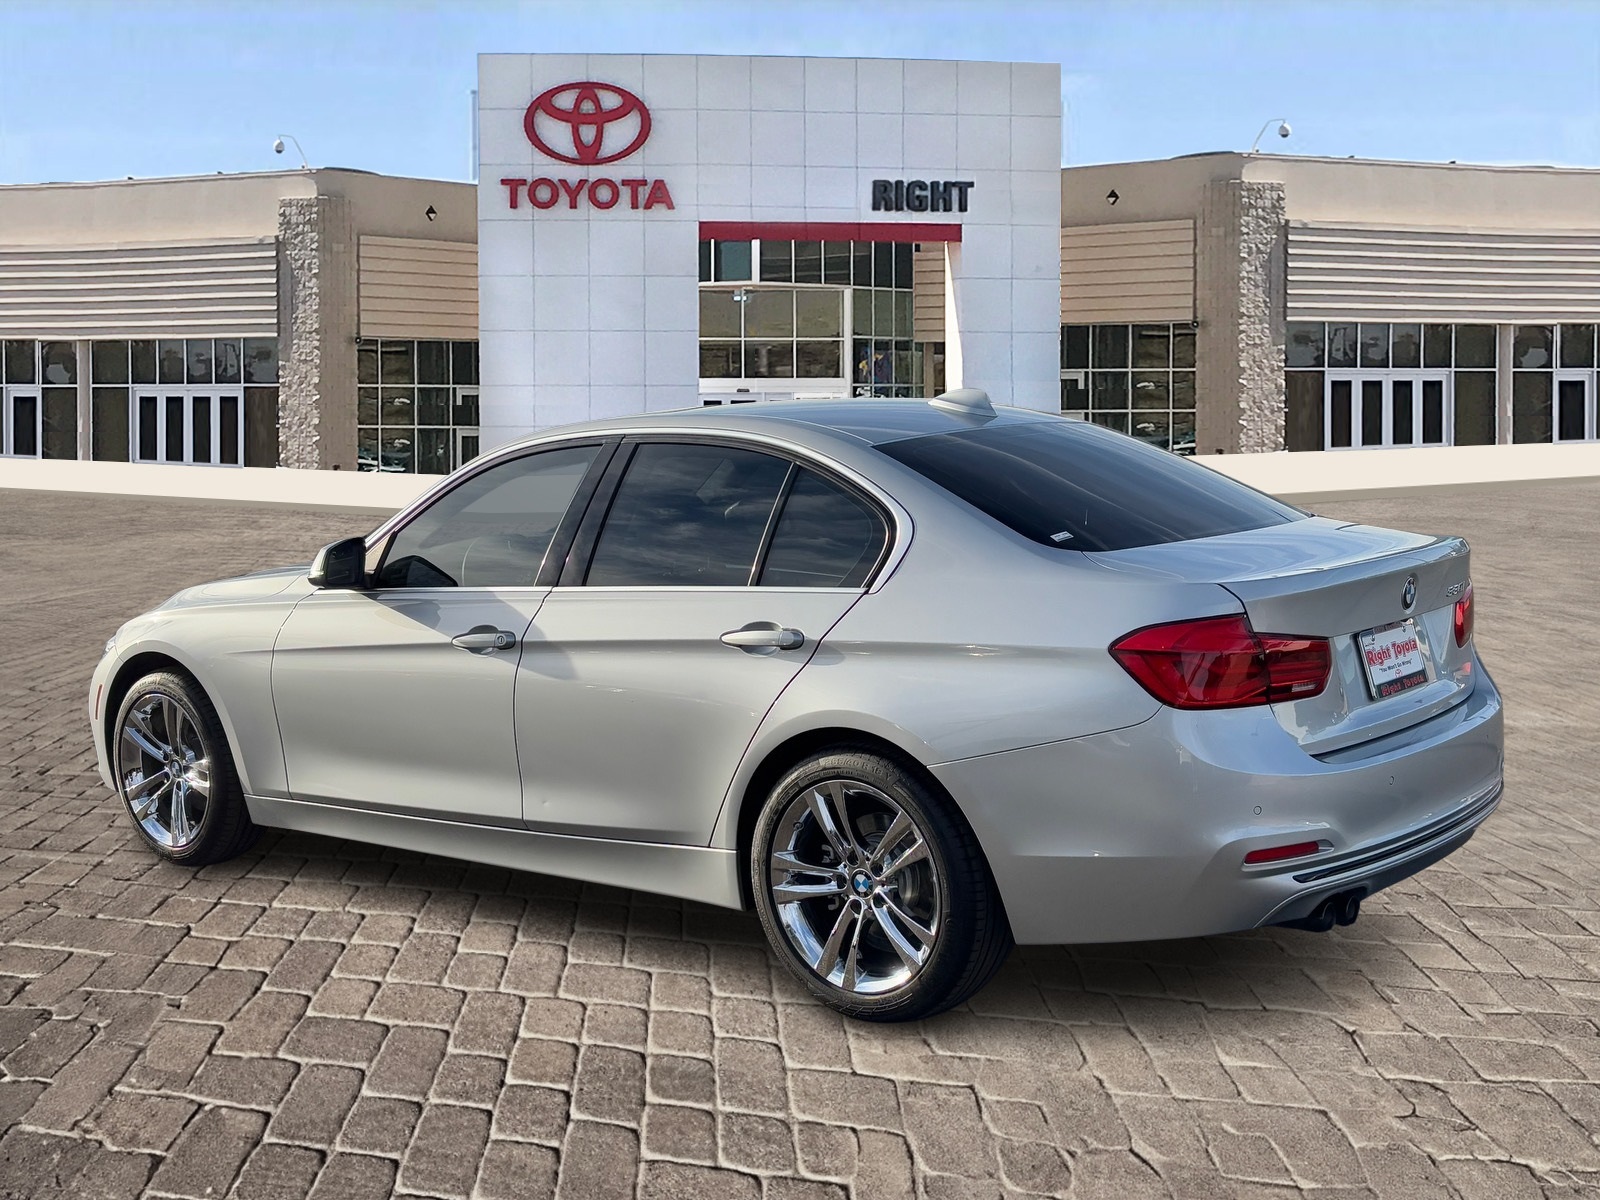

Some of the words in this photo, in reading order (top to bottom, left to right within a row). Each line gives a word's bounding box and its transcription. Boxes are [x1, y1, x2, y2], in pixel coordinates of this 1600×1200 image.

[500, 177, 676, 210] TOYOTA
[872, 179, 975, 212] RIGHT
[1366, 645, 1392, 667] Right
[1391, 638, 1418, 660] Toyota
[1381, 683, 1401, 697] Right
[1402, 675, 1425, 689] Toyota
